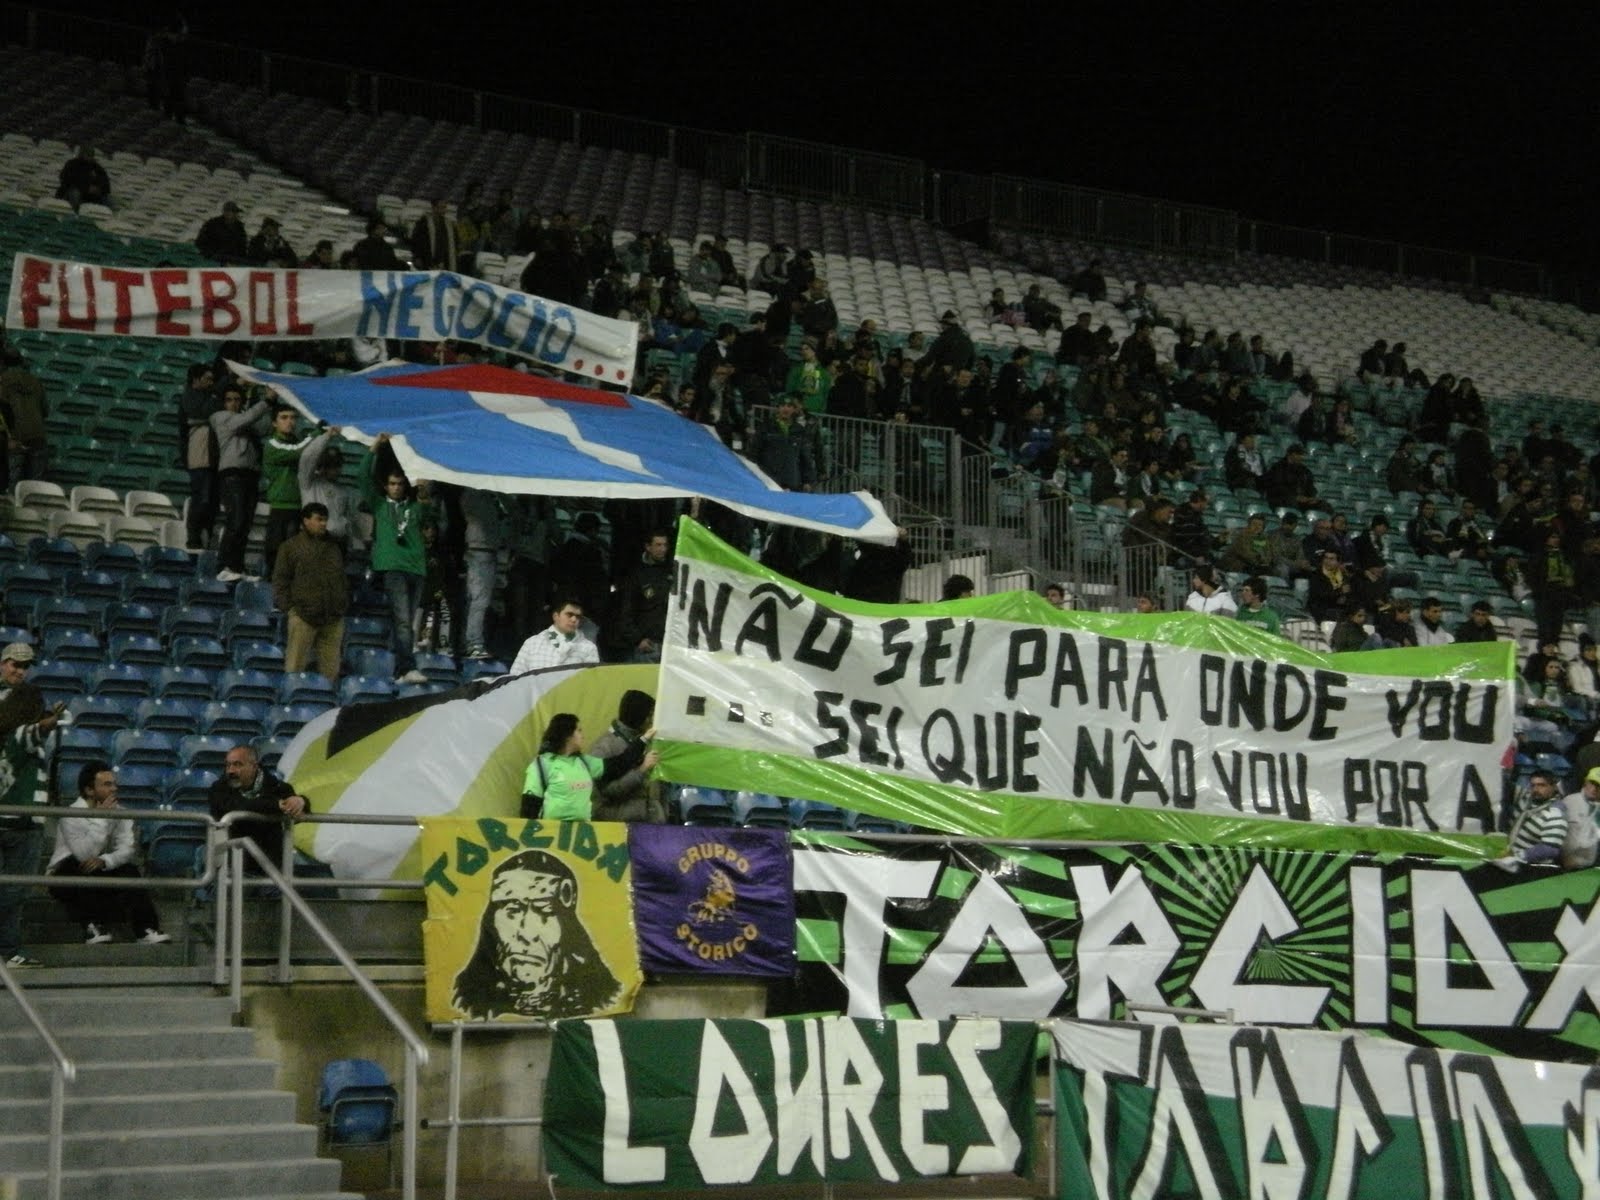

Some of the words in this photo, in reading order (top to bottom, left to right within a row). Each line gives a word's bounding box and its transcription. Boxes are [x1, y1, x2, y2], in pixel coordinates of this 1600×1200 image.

[21, 257, 314, 337] FUTEBOL
[873, 617, 975, 688] SEI
[1005, 628, 1168, 723] PARA
[1200, 653, 1348, 741] ONDE
[1386, 679, 1498, 744] VOU
[813, 690, 904, 771] SEI
[920, 708, 1042, 792] QUE
[1073, 725, 1197, 810] NÃO
[1212, 750, 1311, 822] VOU
[1343, 757, 1440, 833] POR
[424, 817, 630, 897] TORCIDA
[679, 842, 750, 874] GRUPPO
[676, 923, 759, 961] STORICO
[585, 1016, 1022, 1184] LOURES
